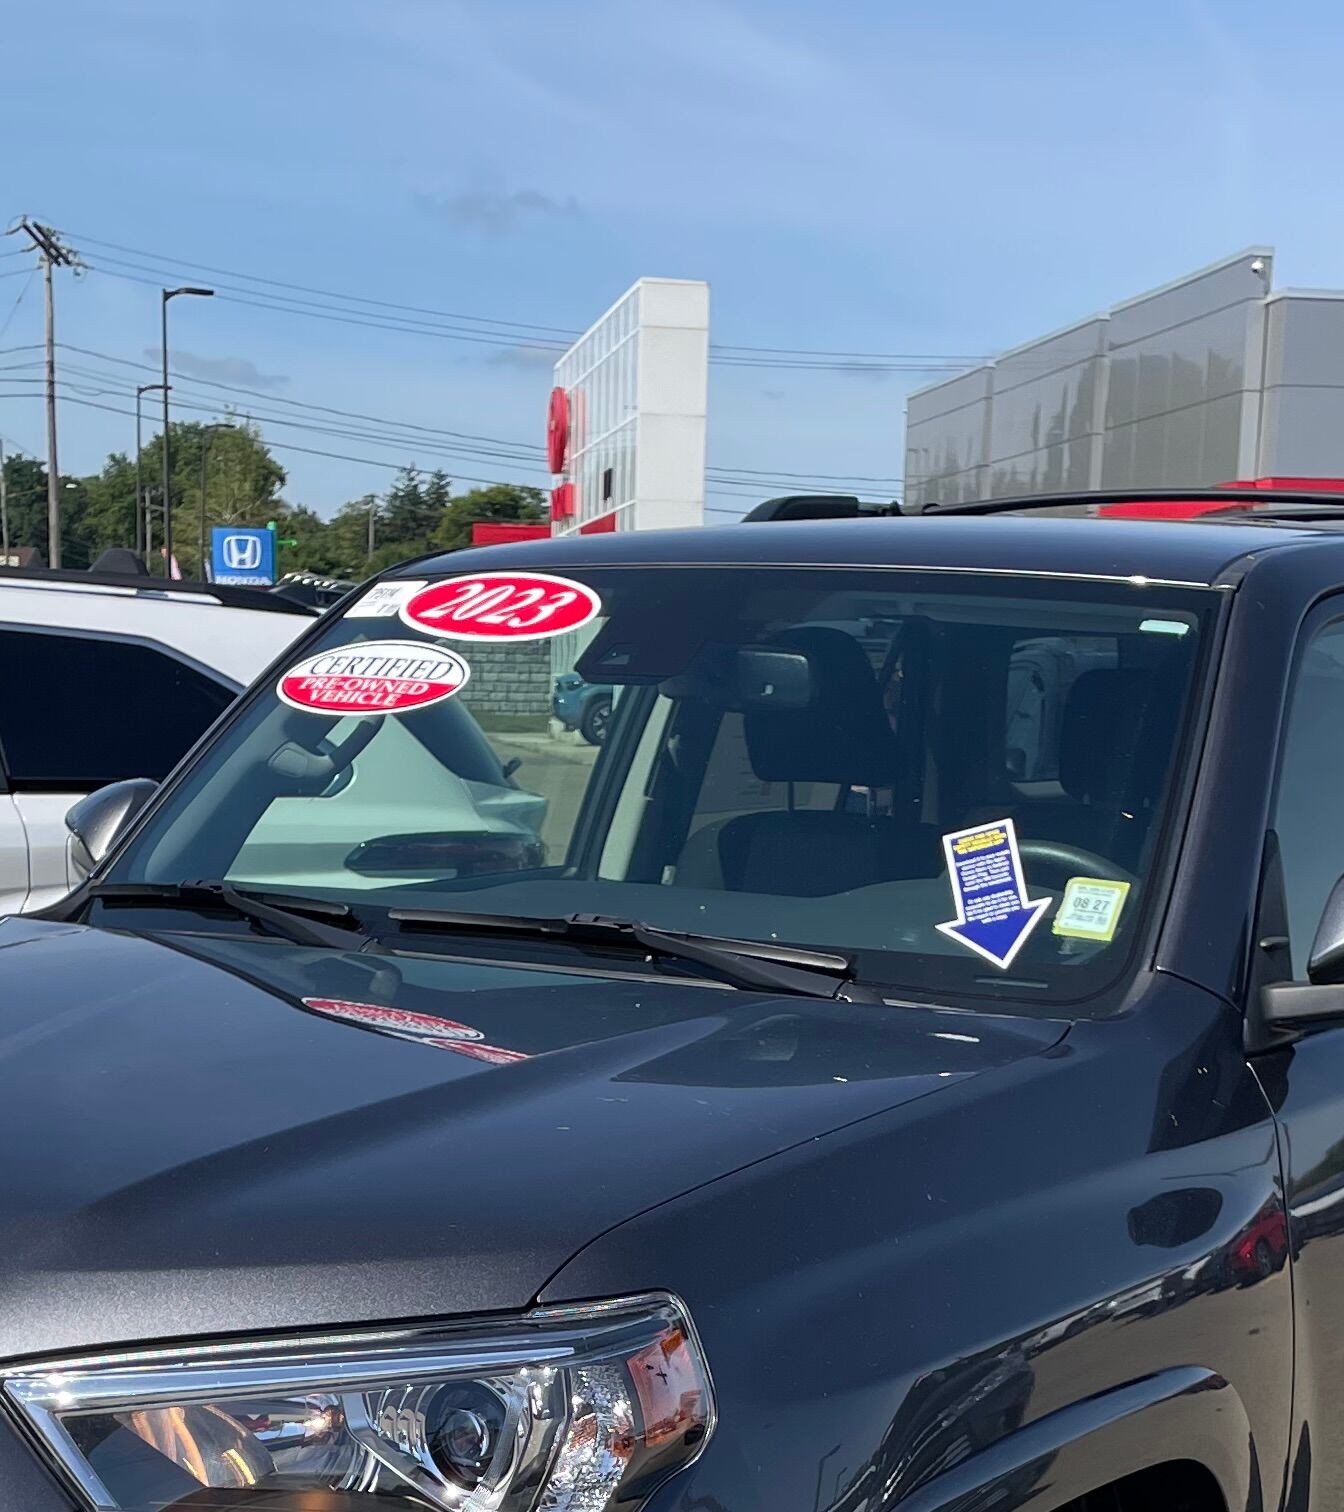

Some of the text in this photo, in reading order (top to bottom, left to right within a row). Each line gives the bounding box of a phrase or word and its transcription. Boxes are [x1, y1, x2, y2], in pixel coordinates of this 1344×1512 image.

[215, 575, 271, 586] HONDA
[417, 582, 577, 628] 2023
[310, 655, 454, 681] CERTIFIED
[301, 677, 429, 696] PRE-OWNED
[310, 687, 403, 707] VEHICLE
